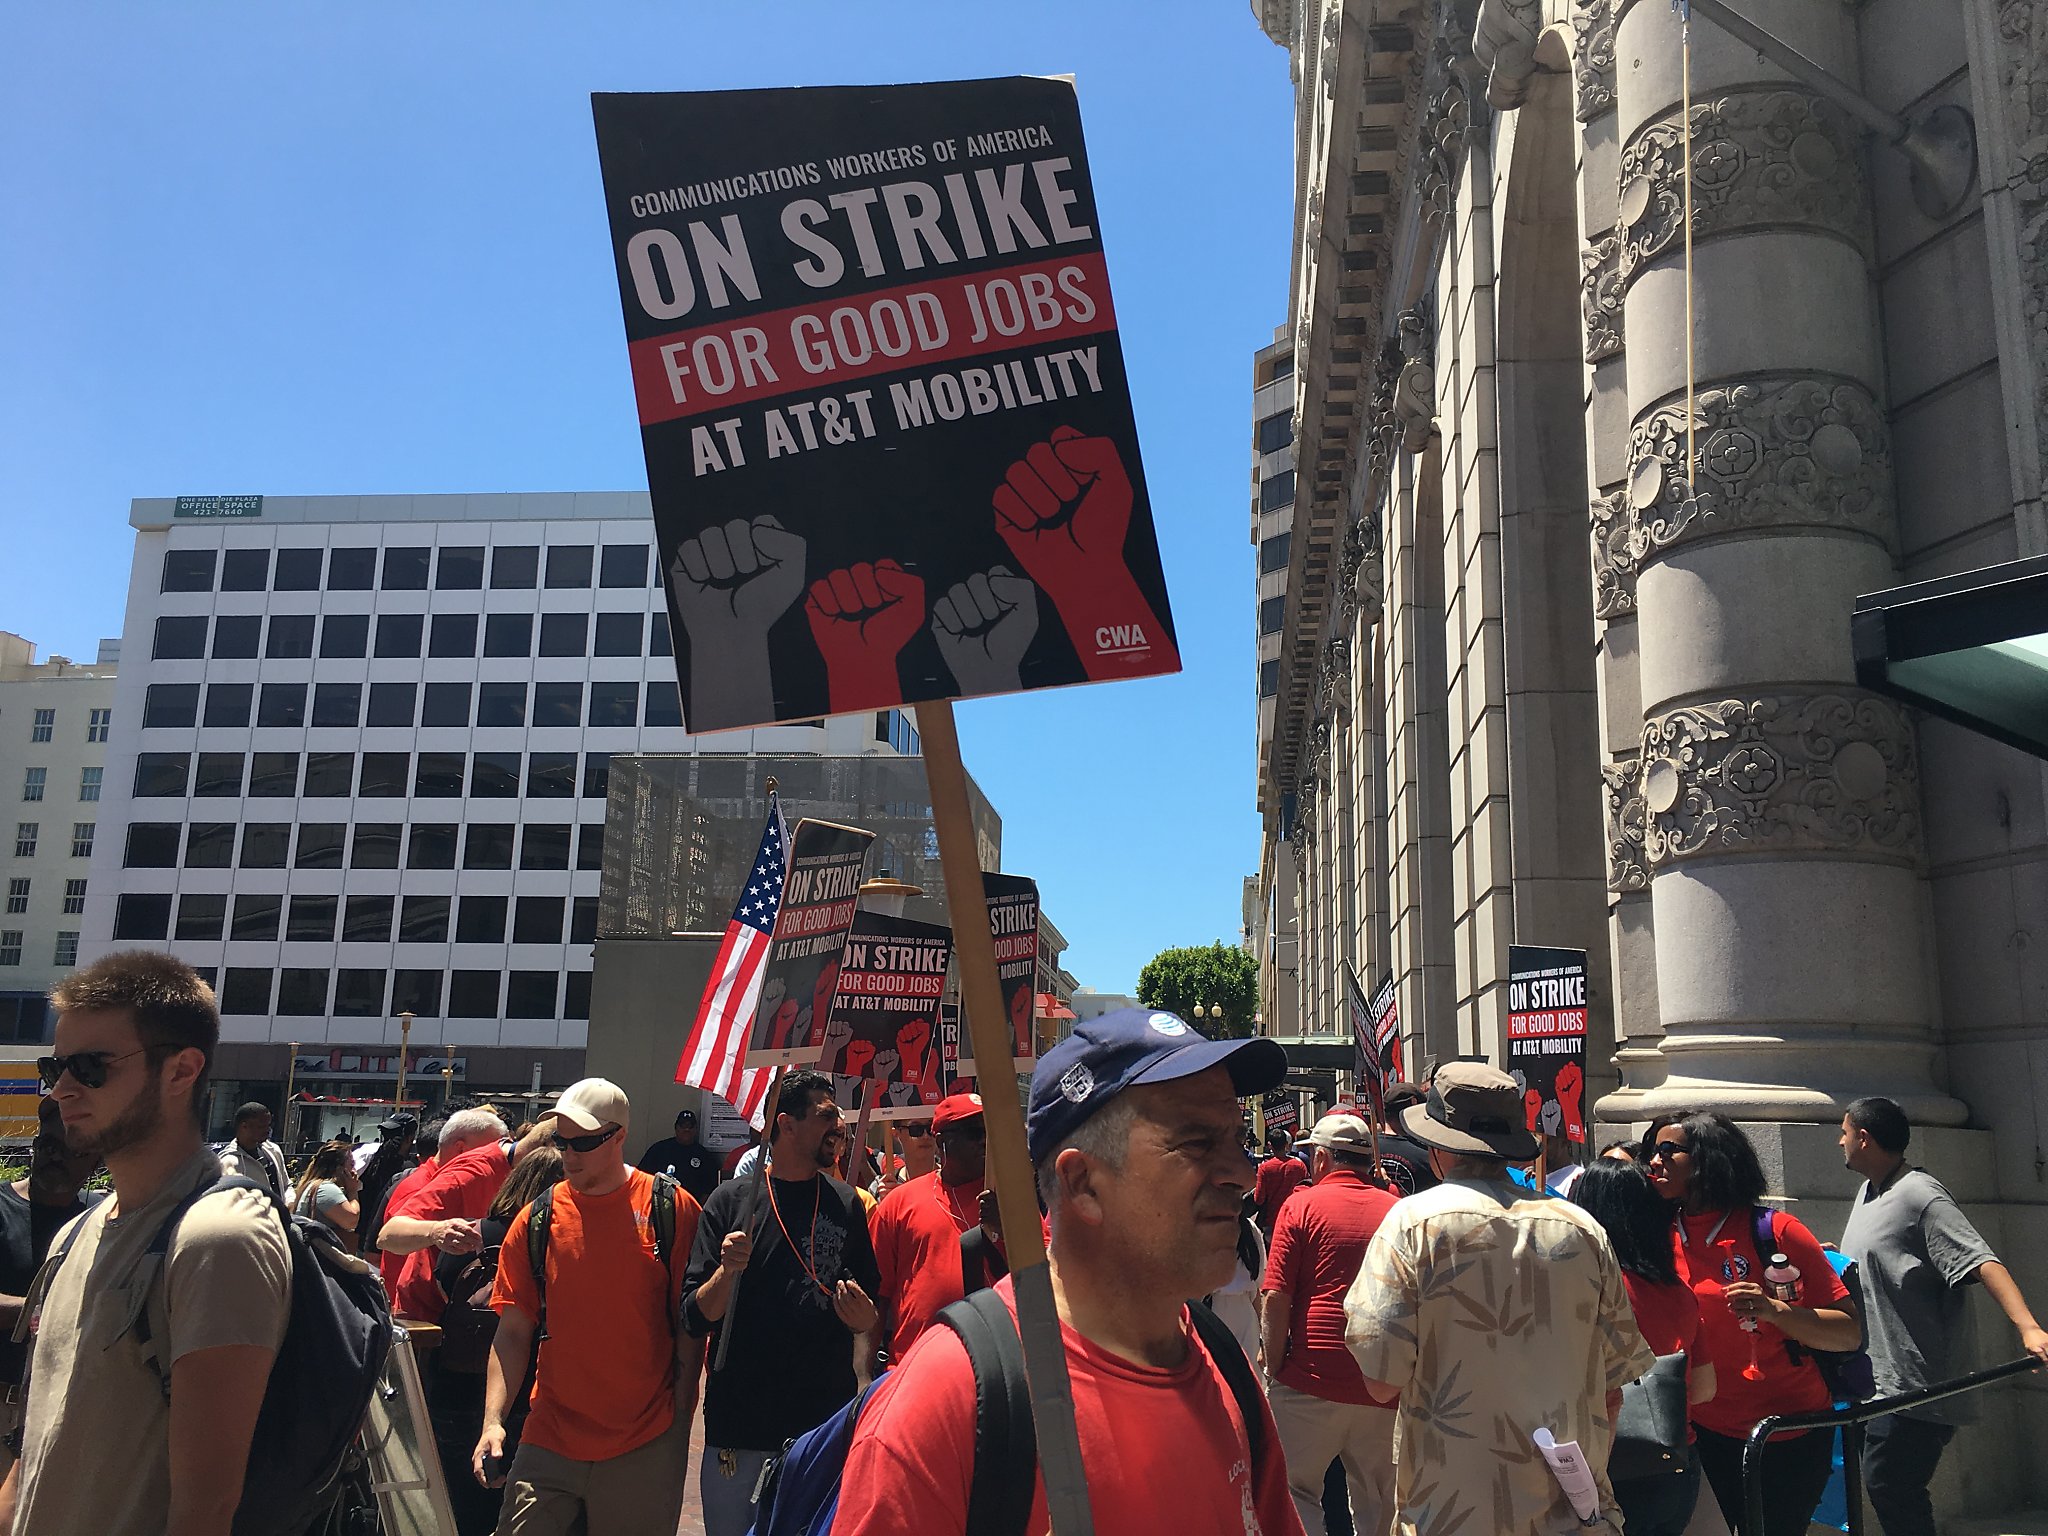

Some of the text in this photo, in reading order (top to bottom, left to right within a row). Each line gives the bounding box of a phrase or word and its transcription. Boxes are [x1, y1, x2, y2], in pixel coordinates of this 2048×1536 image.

[630, 125, 1053, 218] COMMUNICATIONS WORKERS OF AMERICA
[626, 156, 1092, 320] ON STRIKE
[659, 266, 1096, 404] FOR GOOD JOBS
[690, 346, 1103, 477] AT AT&T MOBILITY
[181, 501, 257, 510] OFFICE SPACE
[1095, 624, 1148, 649] CWA
[788, 864, 862, 905] ON STRIKE
[781, 902, 853, 935] FOR GOOD JOBS
[990, 903, 1036, 935] STRIKE
[775, 931, 847, 962] AT AT&T MOBILITY
[890, 936, 915, 945] WORKERS
[923, 938, 946, 946] AMERICA
[994, 936, 1034, 959] OOD JOBS
[842, 943, 948, 973] ON STRIKE
[1000, 960, 1033, 980] MOBILITY
[1564, 965, 1582, 975] AMERICA
[837, 973, 940, 994] FOR GOOD JOBS
[1509, 976, 1586, 1011] ON STRIKE
[834, 995, 936, 1012] AT AT&T MOBILITY
[1374, 983, 1395, 1025] STRIKE
[1511, 1011, 1584, 1034] FOR GOOD JOBS
[1512, 1037, 1582, 1056] AT AT&T MOBILITY
[1263, 1112, 1273, 1120] ON
[1273, 1103, 1295, 1117] STRIKE
